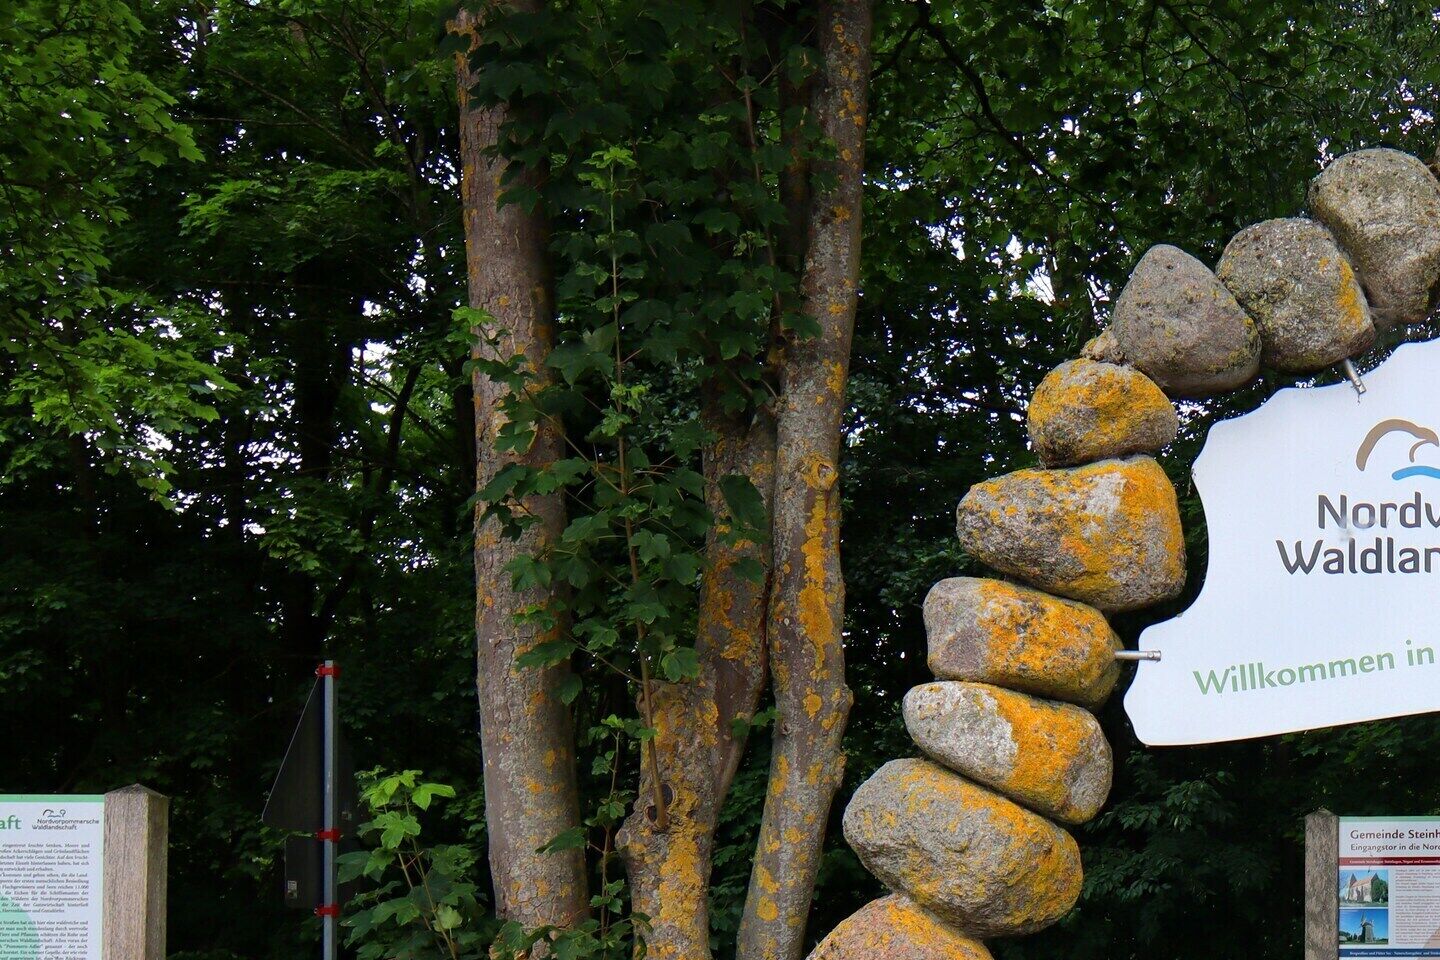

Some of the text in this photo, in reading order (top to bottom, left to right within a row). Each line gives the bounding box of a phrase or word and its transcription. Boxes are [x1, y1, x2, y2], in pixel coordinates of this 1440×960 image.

[1193, 650, 1394, 696] Willkommen
[1406, 639, 1435, 666] in
[1350, 829, 1404, 839] Gemeinde
[1351, 843, 1397, 853] Eingangstor
